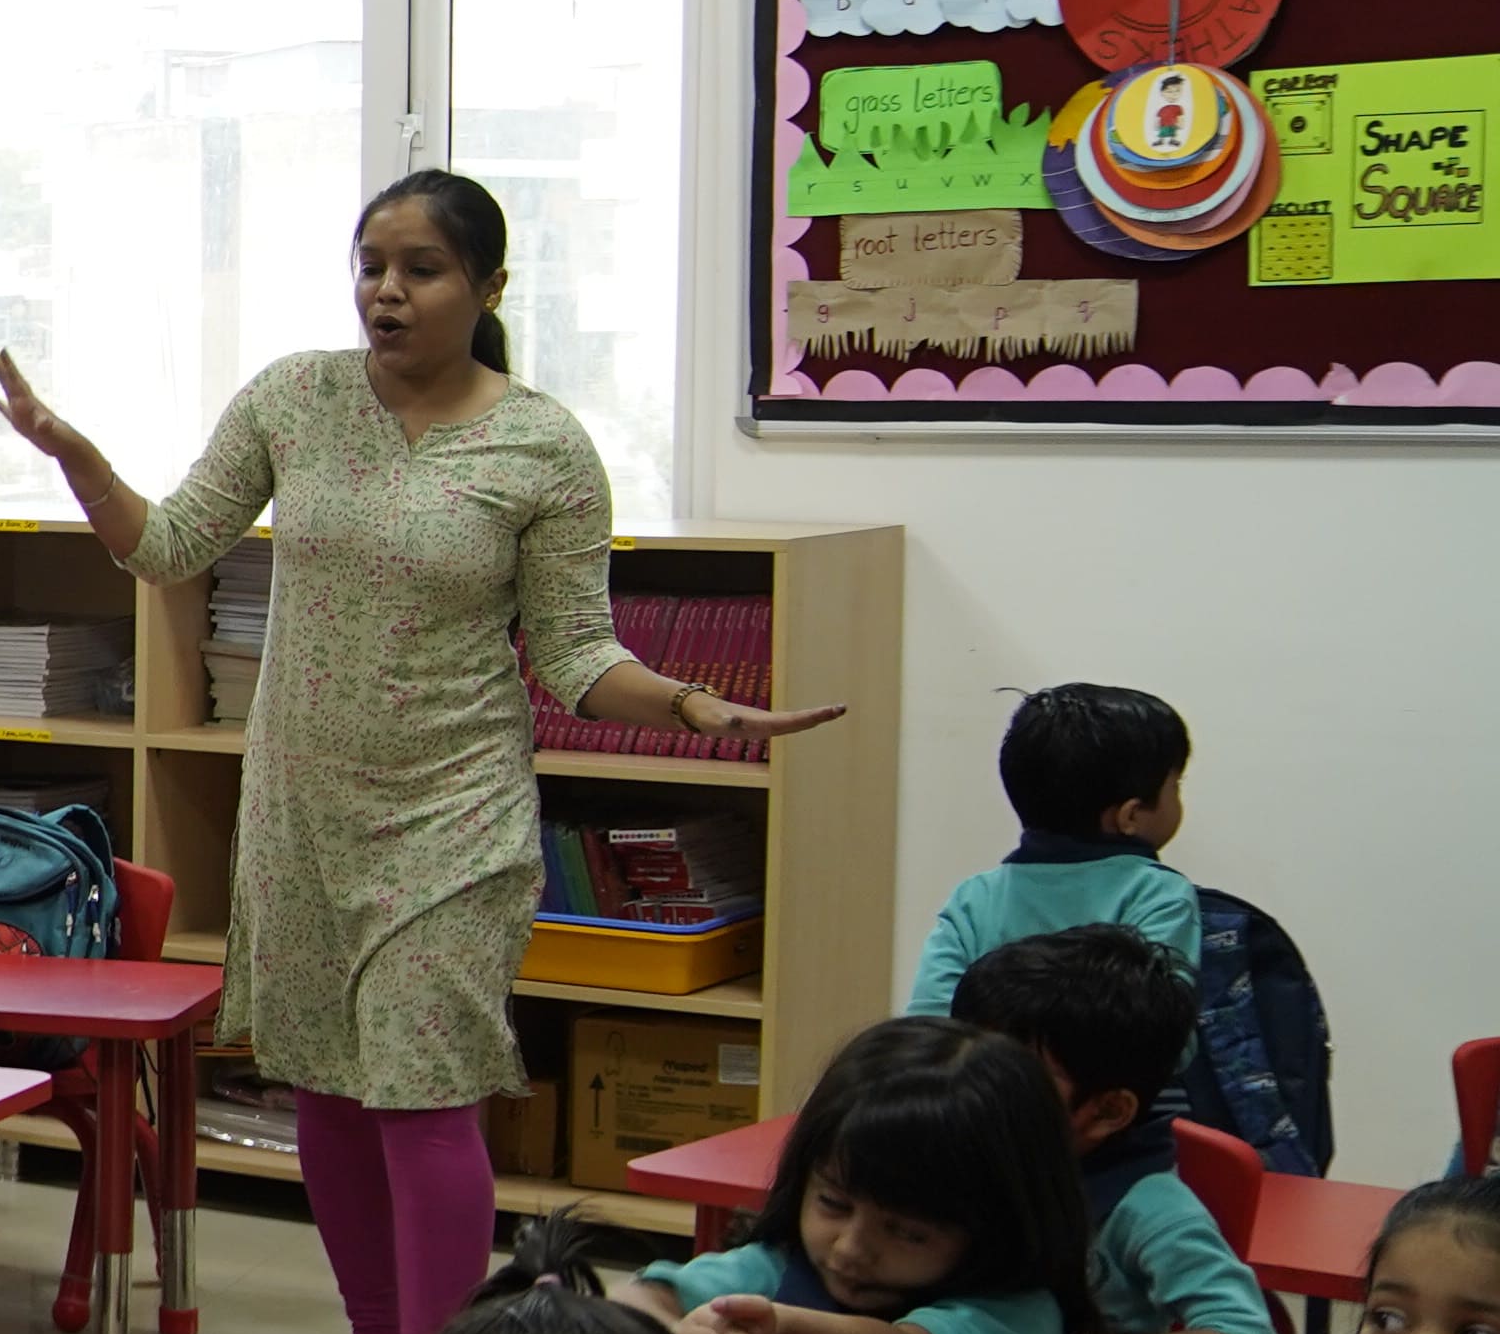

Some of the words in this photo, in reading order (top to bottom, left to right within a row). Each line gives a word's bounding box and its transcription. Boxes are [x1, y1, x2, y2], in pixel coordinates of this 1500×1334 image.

[845, 92, 901, 134] grass
[913, 77, 994, 112] letters
[1360, 120, 1468, 156] SHAPE
[853, 179, 863, 193] s
[896, 177, 908, 190] u
[1355, 163, 1483, 222] SQUARE
[854, 226, 899, 259] root
[914, 220, 997, 253] letters
[994, 306, 1008, 330] p
